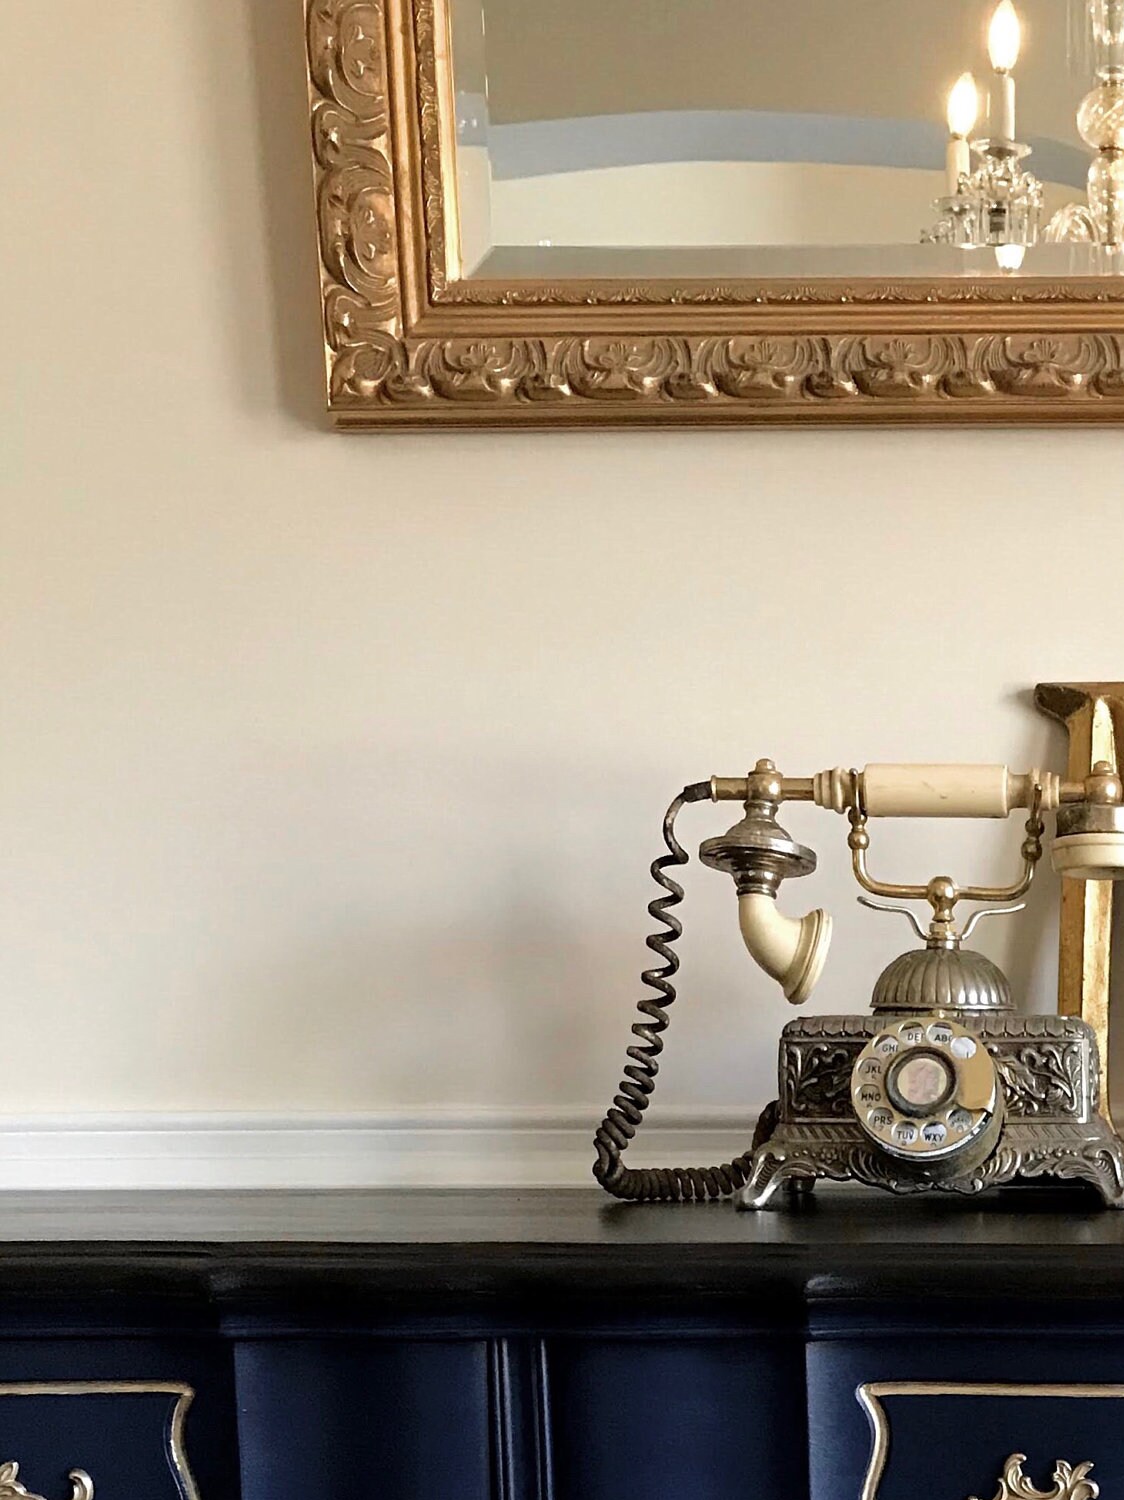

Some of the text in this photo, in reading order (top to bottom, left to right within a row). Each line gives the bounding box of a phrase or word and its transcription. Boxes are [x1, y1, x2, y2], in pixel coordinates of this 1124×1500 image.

[865, 1065, 882, 1074] JKL
[861, 1093, 881, 1102] MNO
[874, 1115, 893, 1125] PRS
[897, 1130, 944, 1142] TUV WXY
